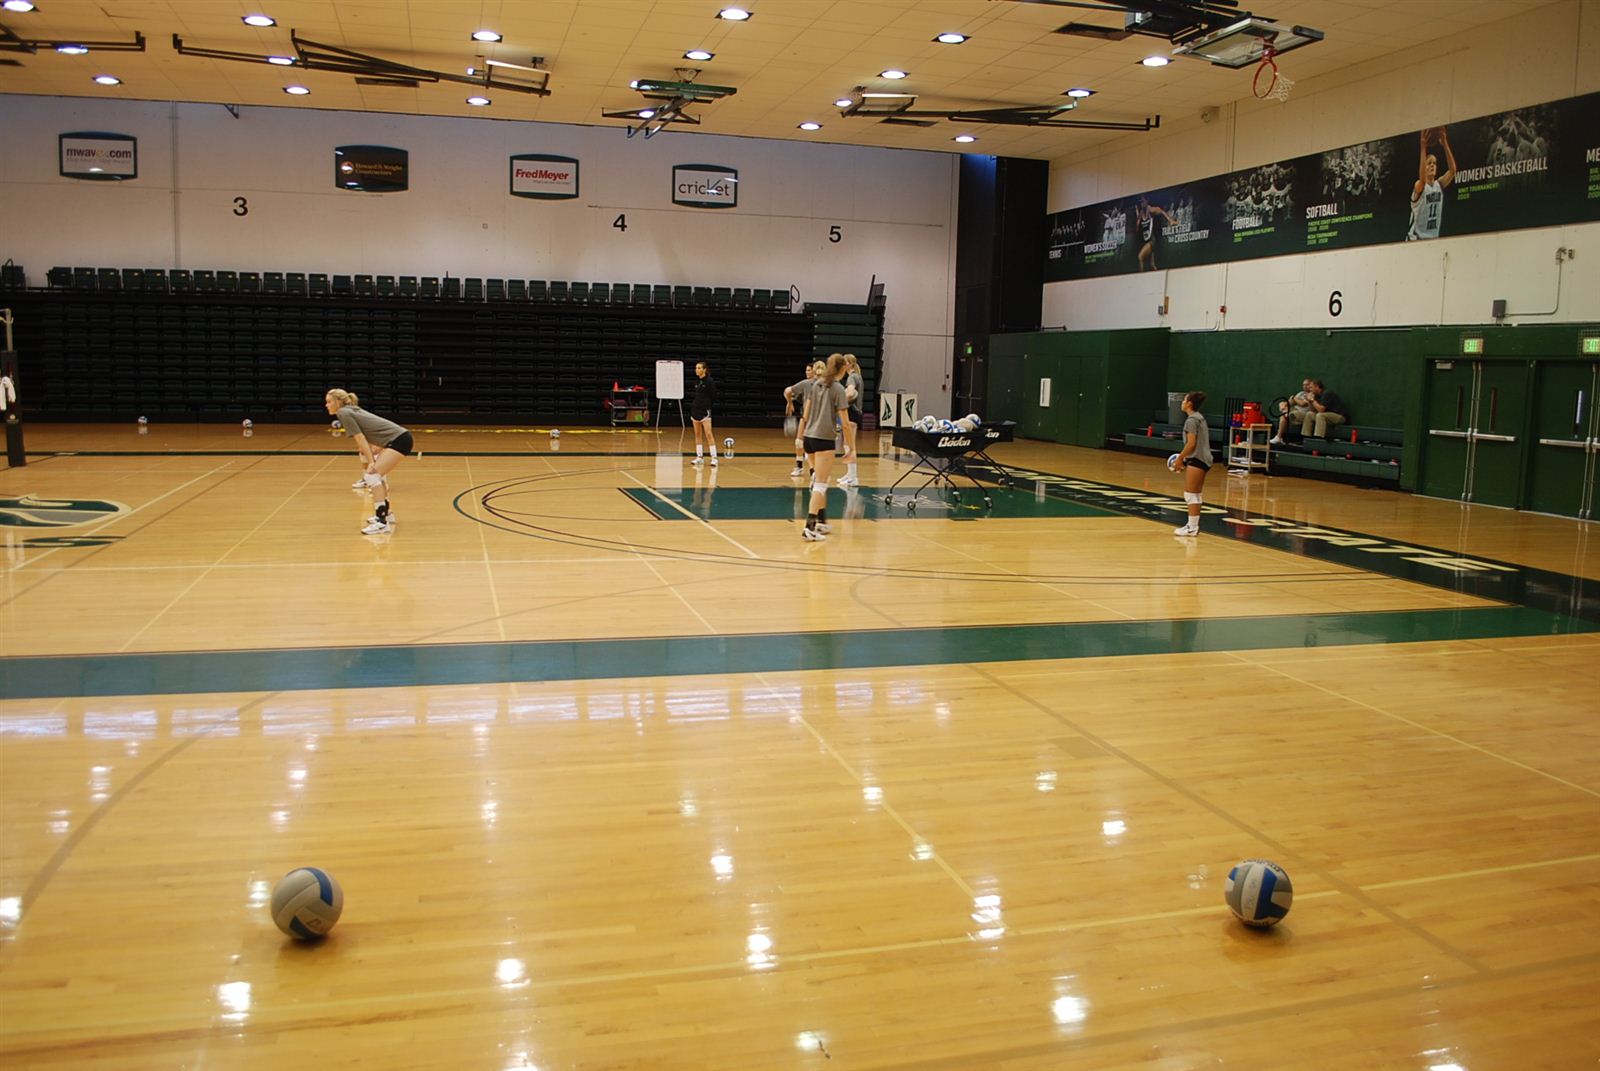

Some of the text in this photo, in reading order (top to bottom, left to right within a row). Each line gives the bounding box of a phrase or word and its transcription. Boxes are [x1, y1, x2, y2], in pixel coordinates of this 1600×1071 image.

[1454, 157, 1549, 184] WOMEN'S BASKETBALL
[678, 178, 730, 196] cricket
[233, 196, 248, 216] 3
[1305, 203, 1338, 219] SOFTBALL
[613, 214, 627, 231] 4
[1232, 215, 1261, 230] FOOTBALL
[829, 225, 842, 243] 5
[1174, 233, 1189, 243] CROSS
[1189, 229, 1210, 241] COUNTRY
[1329, 290, 1342, 317] 6
[1222, 517, 1520, 572] STATE
